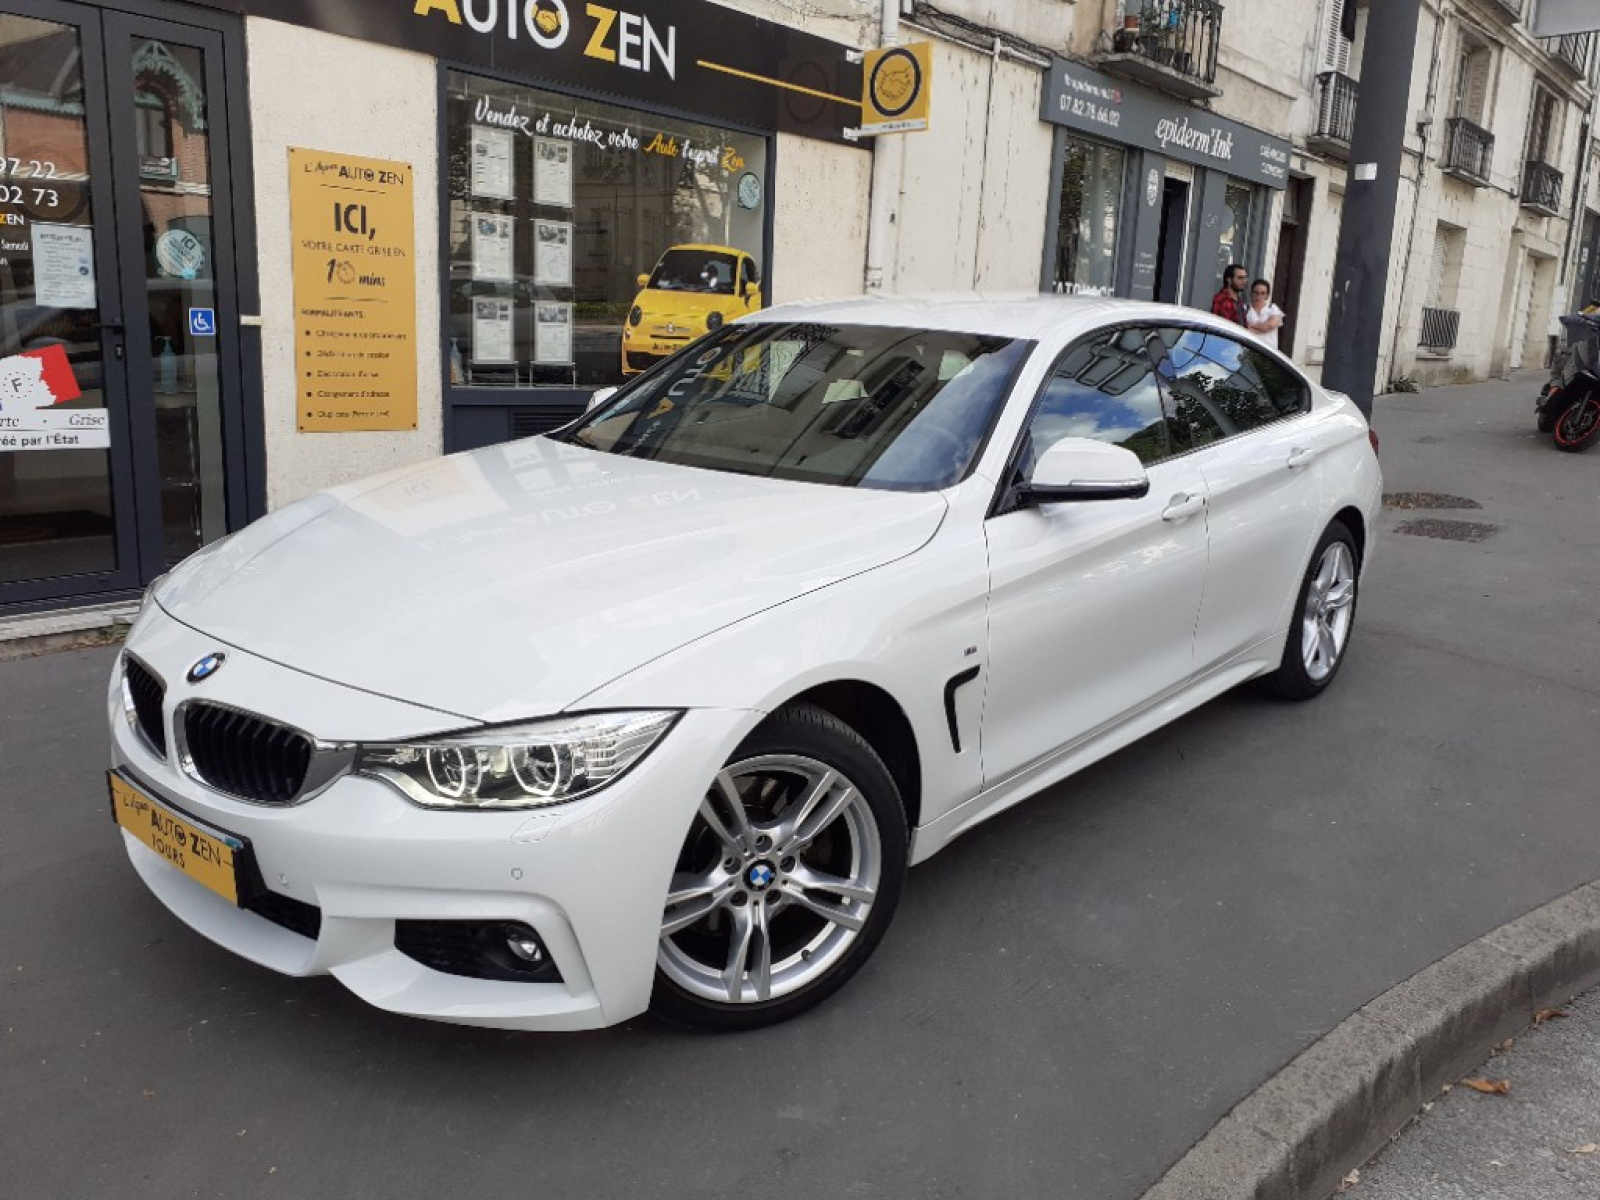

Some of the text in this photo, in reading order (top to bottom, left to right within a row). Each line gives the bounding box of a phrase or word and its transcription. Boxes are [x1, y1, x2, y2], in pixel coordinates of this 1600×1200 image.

[583, 2, 676, 82] ZEN
[474, 95, 533, 136] Vendez
[535, 112, 550, 133] et
[553, 118, 606, 149] achetez
[608, 128, 640, 150] votre
[644, 131, 679, 157] Auto
[722, 146, 745, 173] Zen
[1155, 117, 1234, 160] epiderm'Ink
[30, 161, 57, 179] 22
[338, 166, 374, 181] AUTO
[378, 170, 404, 186] ZEN
[33, 188, 59, 207] 73
[334, 202, 376, 241] ICI,
[301, 240, 333, 252] VOTRE
[335, 243, 364, 253] CARTE
[367, 246, 391, 257] GRISE
[11, 378, 22, 392] F
[69, 414, 105, 426] Grise
[21, 437, 43, 447] par
[46, 432, 79, 445] l'État
[151, 809, 187, 847] AUTO
[190, 832, 221, 867] ZEN
[151, 834, 185, 868] TOURS
